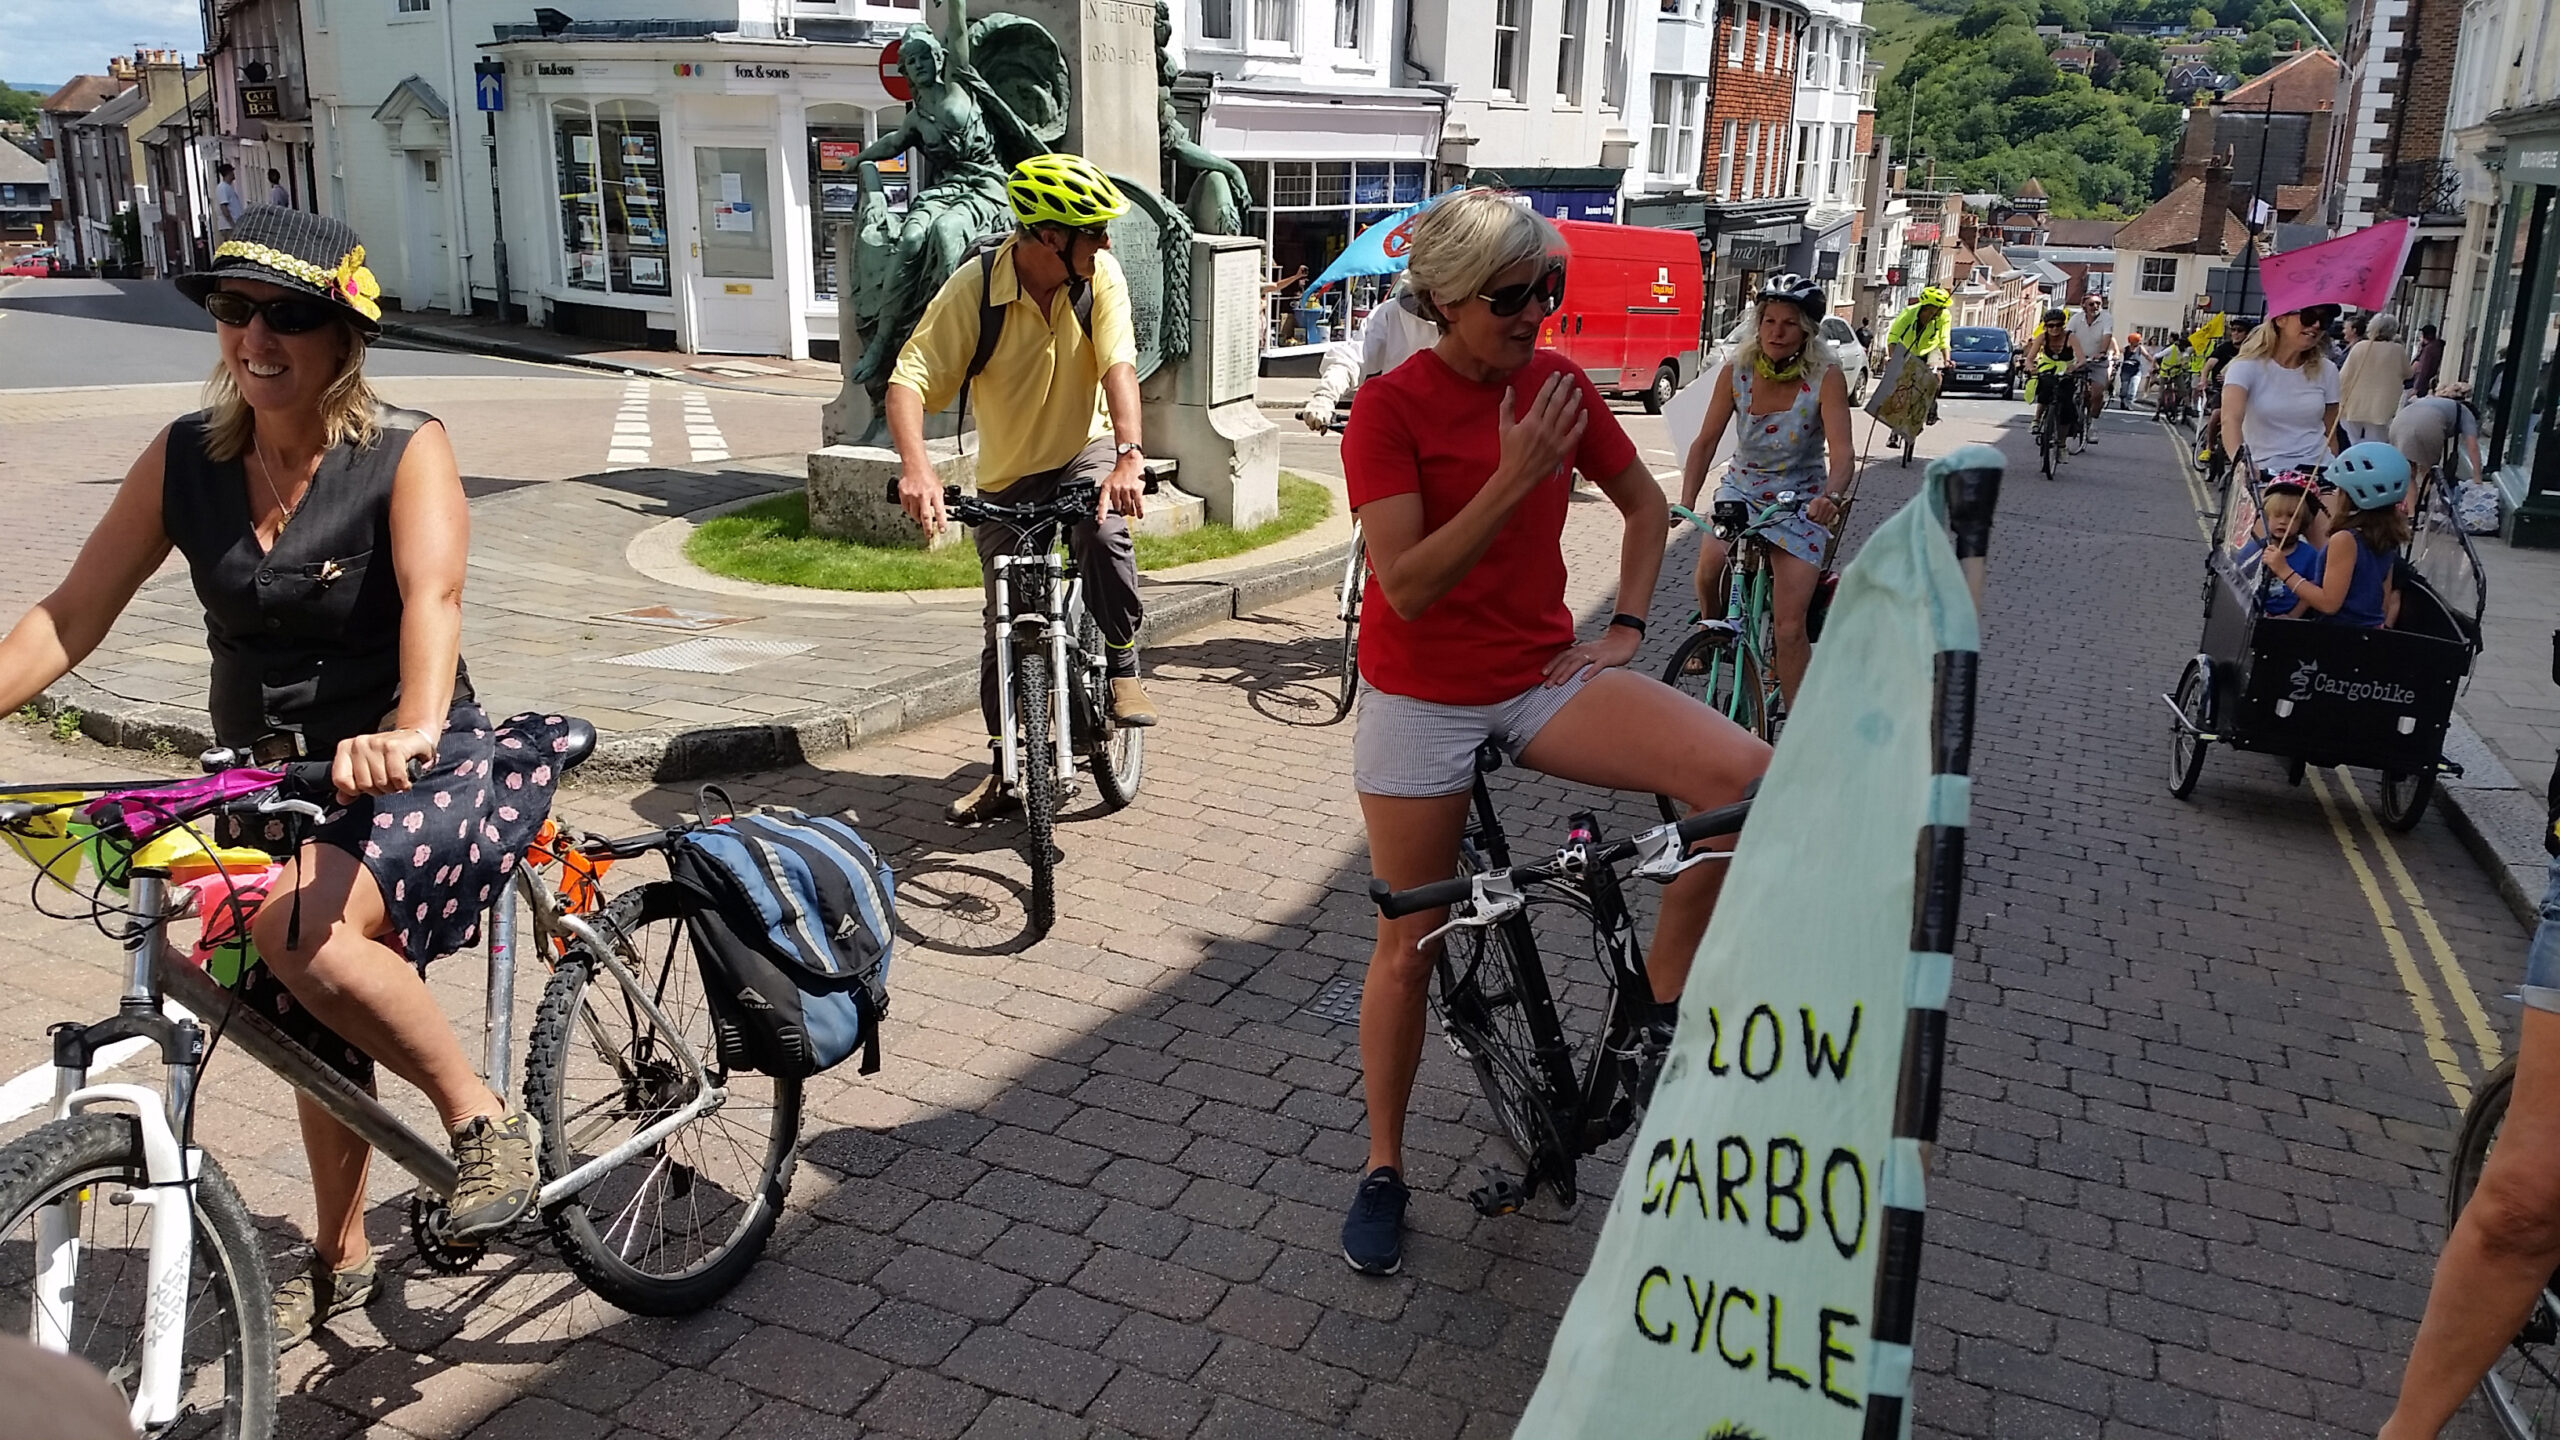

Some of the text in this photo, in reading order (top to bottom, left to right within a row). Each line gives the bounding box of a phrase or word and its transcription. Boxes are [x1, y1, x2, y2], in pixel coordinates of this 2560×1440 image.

[1101, 2, 1125, 24] THE
[1127, 5, 1153, 28] WAR
[735, 64, 754, 78] fox
[765, 68, 790, 79] sons
[2314, 665, 2415, 704] Cargobike
[1707, 1001, 1864, 1083] LOW
[1640, 1134, 1870, 1260] CARBO
[1634, 1264, 1864, 1410] CYCLE
